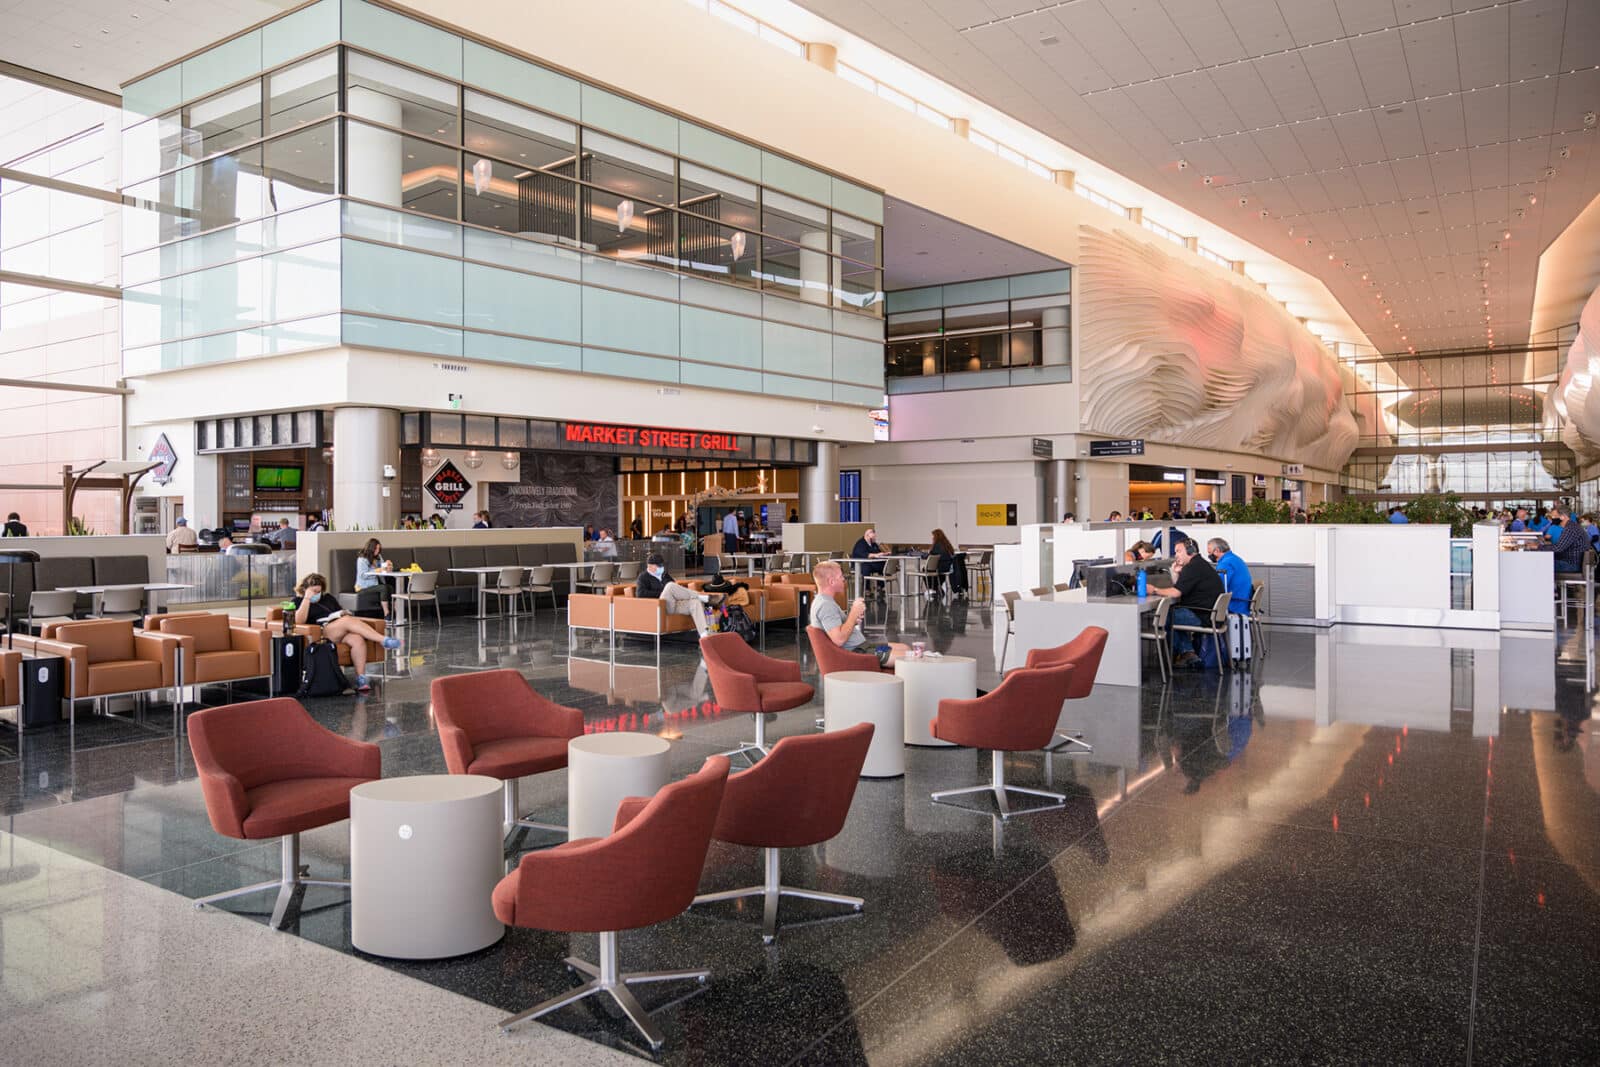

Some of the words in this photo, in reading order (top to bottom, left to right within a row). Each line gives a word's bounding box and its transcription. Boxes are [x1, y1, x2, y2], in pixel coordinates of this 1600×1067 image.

[566, 424, 638, 445] MARKET
[639, 429, 697, 448] STREET
[701, 433, 741, 450] GRILL
[435, 469, 464, 482] MARKET
[435, 482, 465, 491] GRILL
